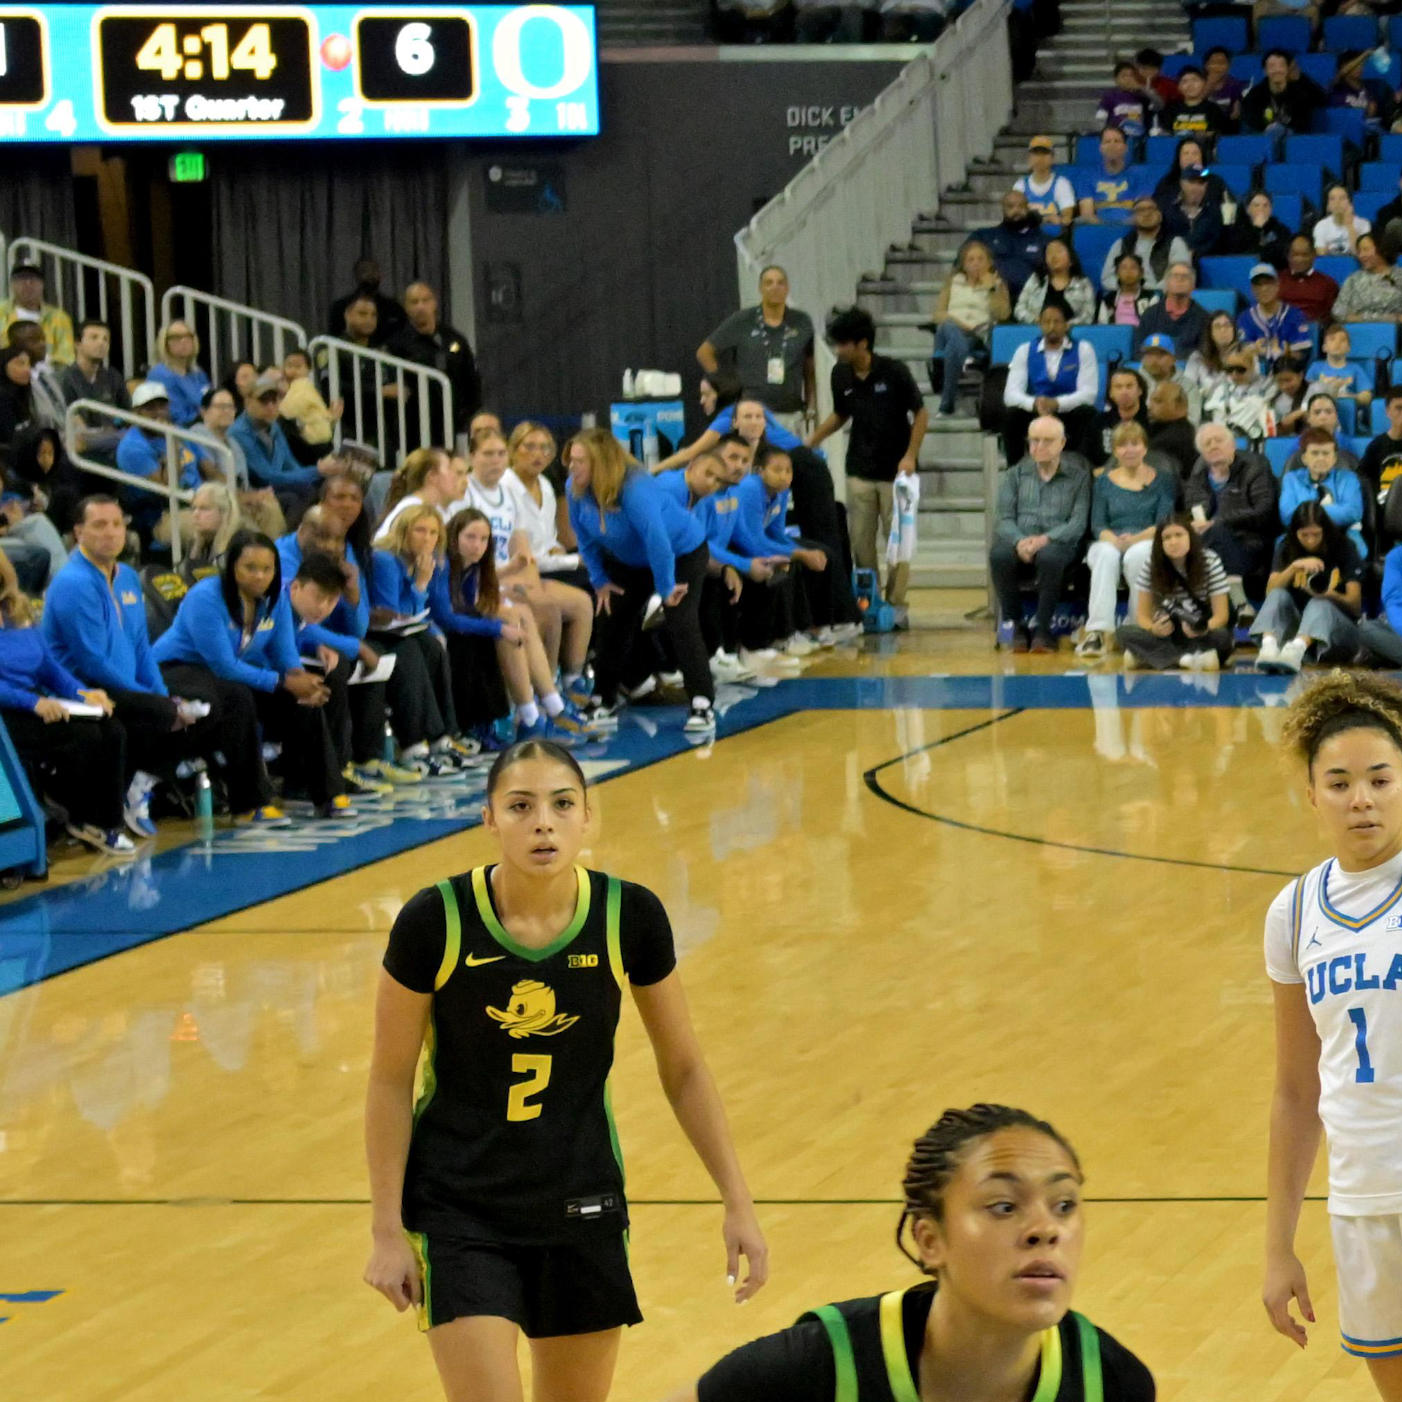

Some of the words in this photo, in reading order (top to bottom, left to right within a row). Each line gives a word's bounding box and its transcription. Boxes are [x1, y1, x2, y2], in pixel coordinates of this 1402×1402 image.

[135, 22, 278, 81] 4:14
[395, 21, 435, 76] 6
[787, 105, 835, 128] DICK
[1348, 1007, 1375, 1083] 1
[507, 1053, 552, 1122] 2
